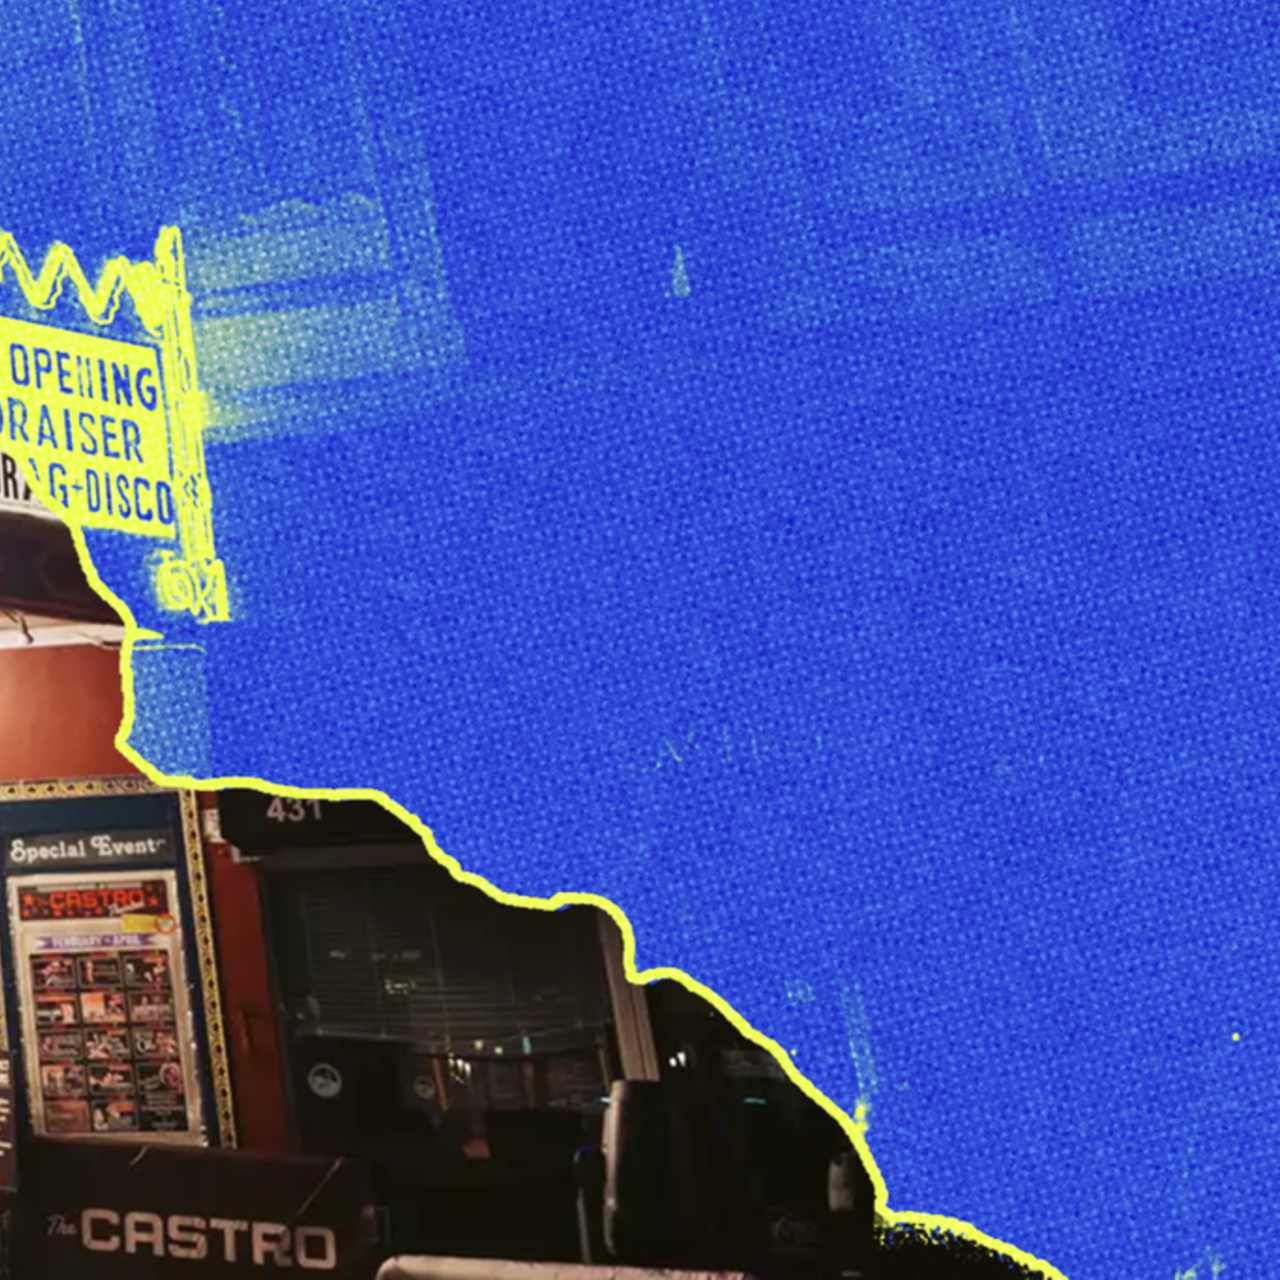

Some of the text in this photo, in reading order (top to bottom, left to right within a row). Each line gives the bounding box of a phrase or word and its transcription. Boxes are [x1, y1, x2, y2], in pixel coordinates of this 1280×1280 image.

[266, 796, 322, 823] 431
[9, 837, 87, 864] Special
[50, 888, 144, 908] CASTRO
[45, 1207, 338, 1271] The CASTRO
